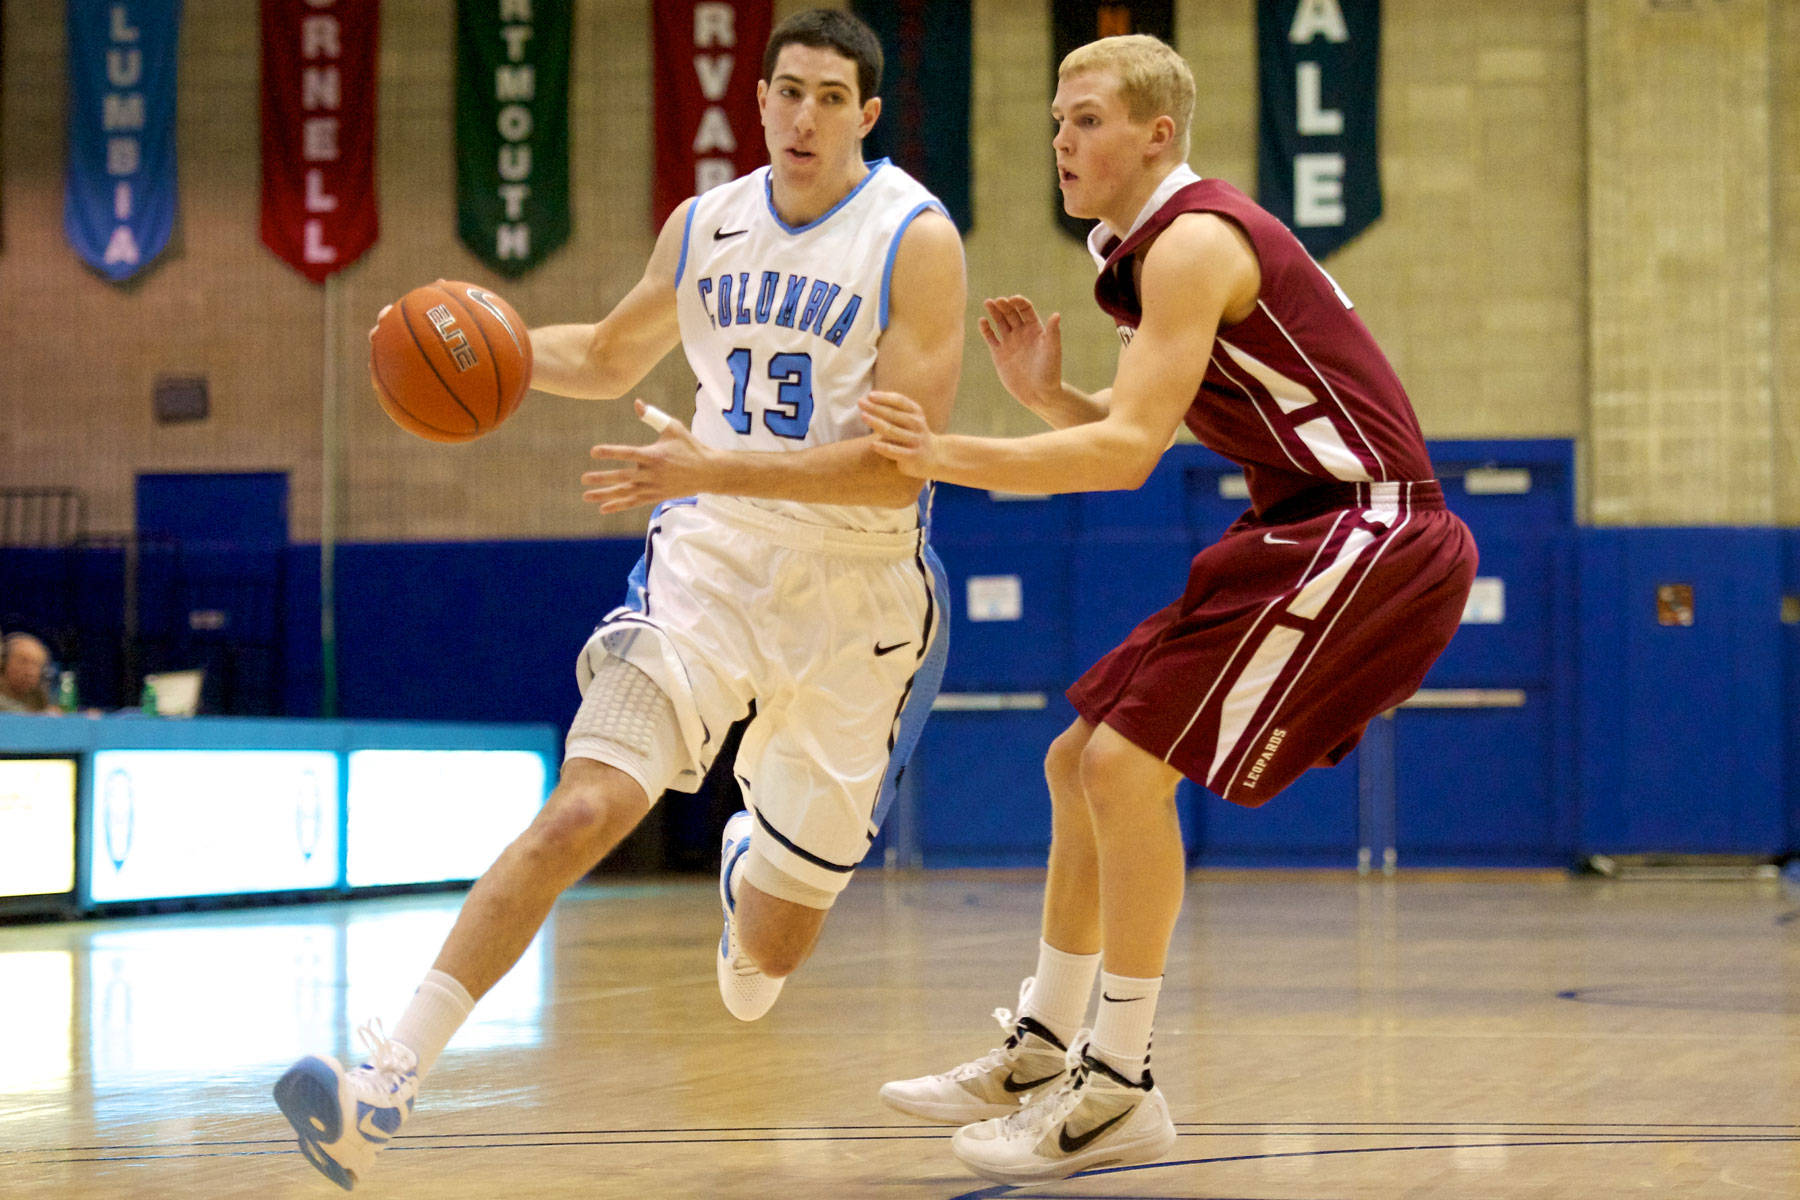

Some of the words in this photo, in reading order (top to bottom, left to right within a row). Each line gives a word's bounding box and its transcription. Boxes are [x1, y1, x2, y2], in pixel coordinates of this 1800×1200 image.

[302, 0, 341, 264] RNELL
[426, 304, 478, 372] ELITE
[698, 271, 862, 347] COLUMBIA
[722, 348, 814, 440] 13
[1243, 728, 1287, 789] LEOPARDS
